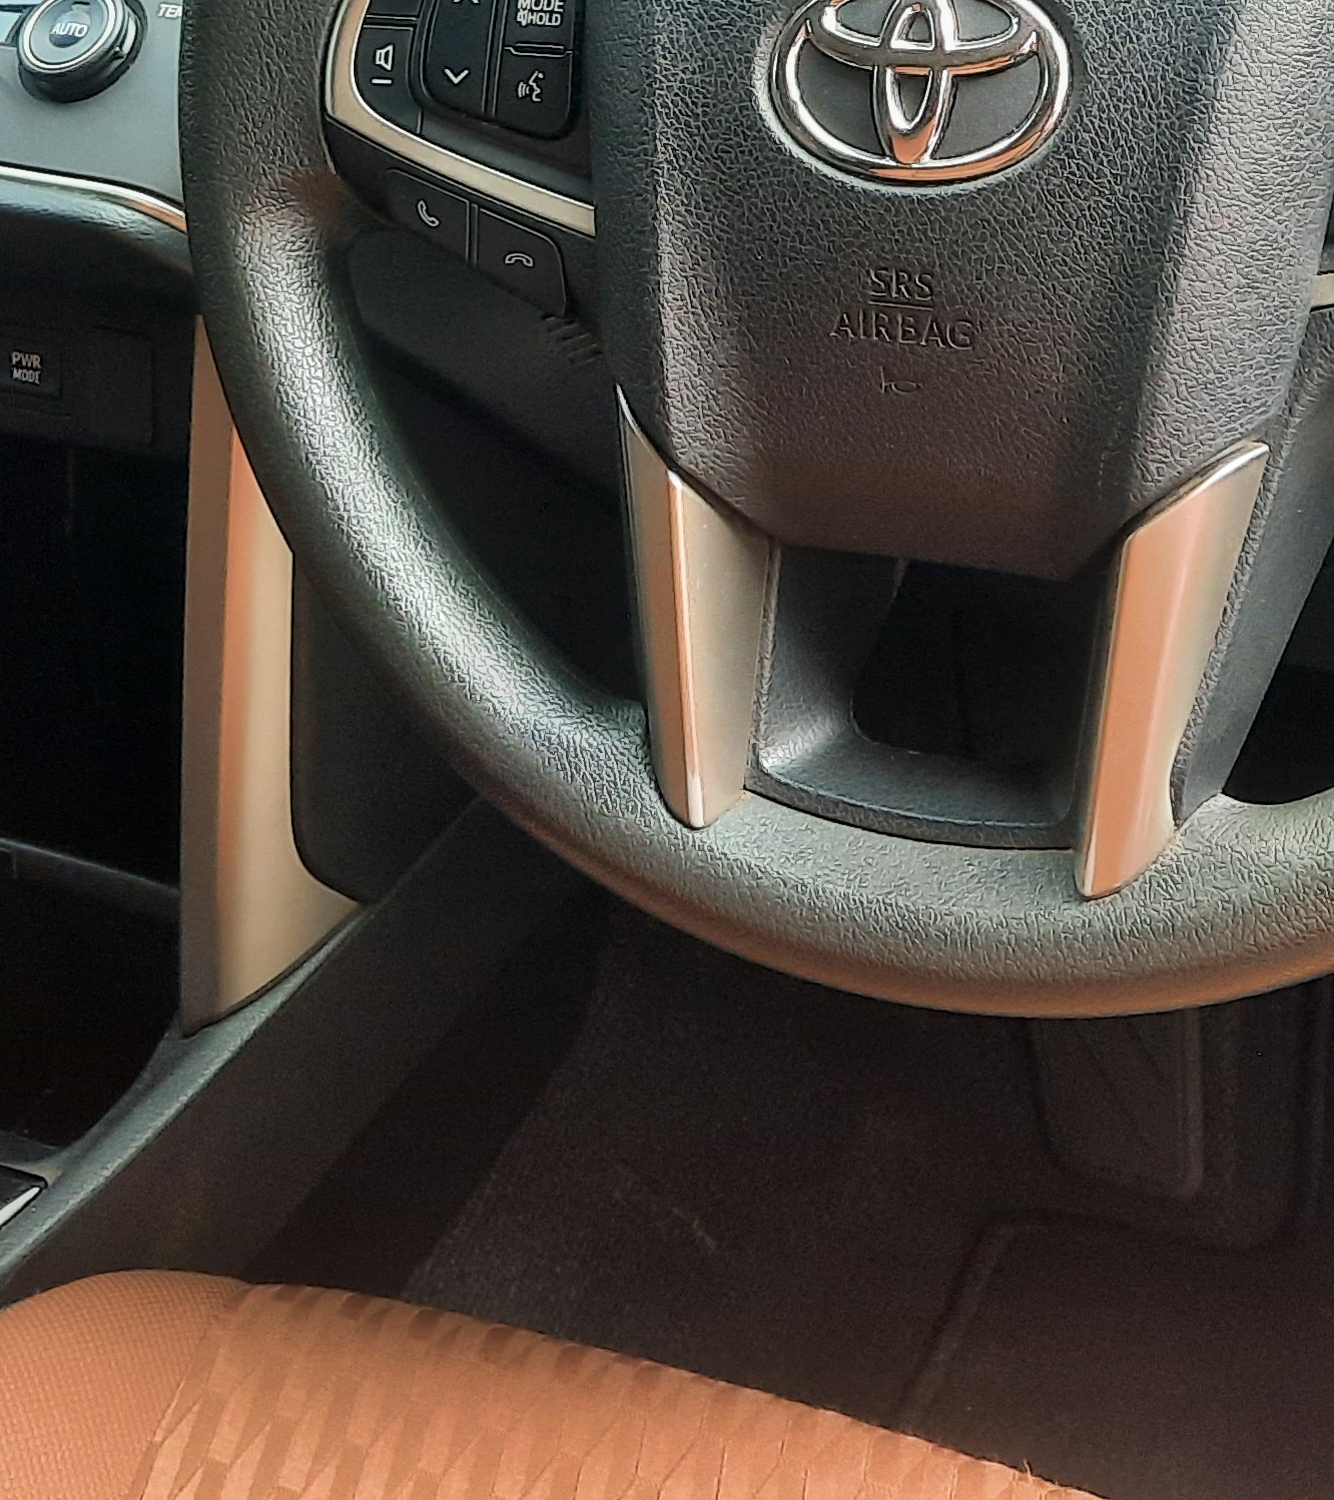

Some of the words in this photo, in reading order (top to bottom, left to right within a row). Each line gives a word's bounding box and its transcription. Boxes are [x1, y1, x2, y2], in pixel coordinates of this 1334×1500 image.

[528, 11, 561, 26] HOLD
[50, 21, 87, 37] AUTO
[867, 267, 934, 301] SRS
[829, 309, 974, 350] AIRBAG
[12, 351, 41, 369] PWR
[12, 367, 41, 385] MODE
